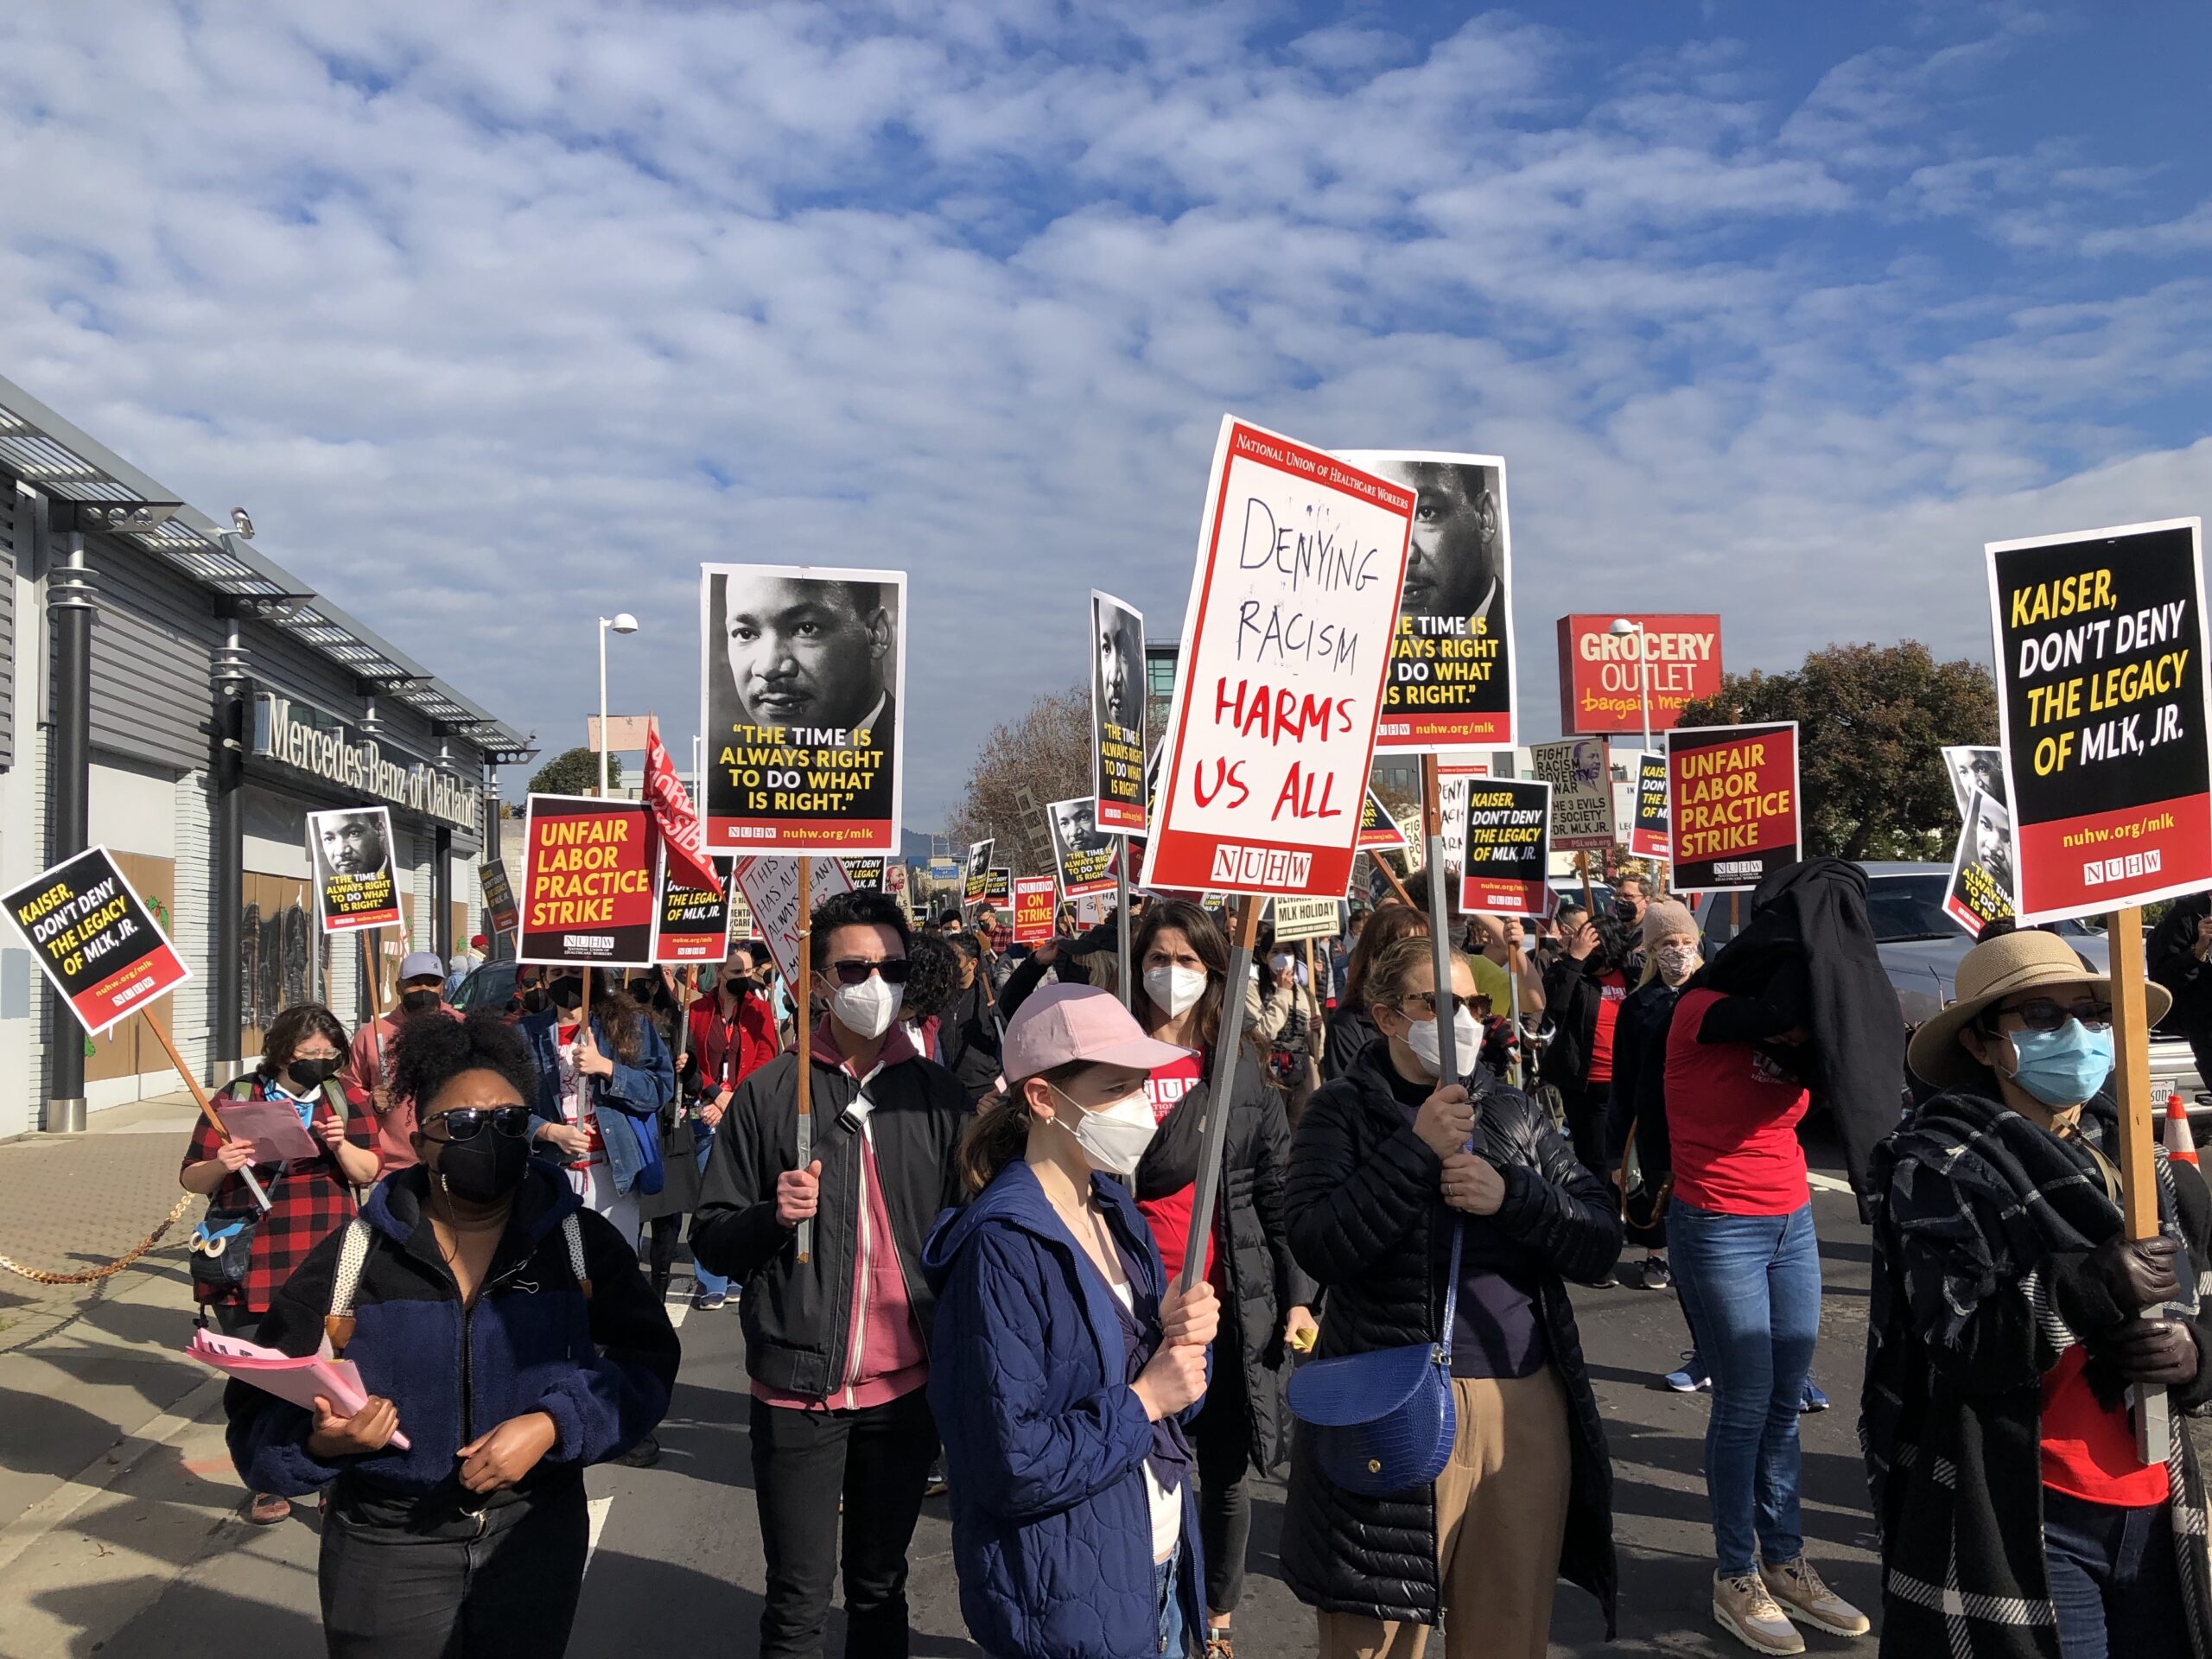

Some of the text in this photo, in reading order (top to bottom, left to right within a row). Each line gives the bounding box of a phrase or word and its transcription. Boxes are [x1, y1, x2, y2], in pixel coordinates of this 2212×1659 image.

[1236, 433, 1408, 510] NATIONAL UNION OF HEALTHCARE WORKERS
[1240, 497, 1379, 592] DENYING
[2012, 569, 2117, 628] KAISER,
[1418, 616, 1487, 635] TIME IS
[1236, 600, 1358, 676] RACISM
[1580, 632, 1714, 661] GROCERY
[2019, 600, 2185, 678] DON’T DENY
[1441, 639, 1498, 658] RIGHT
[1398, 662, 1492, 681] DO WHAT
[1601, 663, 1697, 691] OUTLET
[1407, 684, 1476, 704] RIGHT.”
[2028, 649, 2189, 728] THE LEGACY
[1215, 677, 1357, 747] HARMS
[1581, 688, 1653, 719] bargain
[733, 724, 872, 747] “THE TIME IS
[1122, 728, 1135, 745] TIME
[1135, 732, 1141, 747] IS
[1378, 722, 1494, 735] UHW nuhw.org/mlk
[2035, 703, 2183, 776] OF MLK, JR.
[267, 692, 475, 830] Mercedes-Benz of Oakland
[719, 747, 884, 768] ALWAYS RIGHT
[1102, 741, 1143, 765] ALWAYS RIGHT
[1536, 747, 1571, 760] FIGHT
[1681, 743, 1765, 780] UNFAIR
[1105, 760, 1141, 781] TO DO WHAT
[1537, 759, 1580, 772] RACISM
[728, 769, 874, 790] TO DO WHAT
[1539, 769, 1589, 783] POVERTY
[1111, 779, 1118, 794] IS
[1193, 756, 1249, 809] US
[1271, 760, 1342, 822] ALL
[1553, 782, 1579, 795] WAR
[1681, 771, 1758, 805] LABOR
[748, 791, 854, 811] IS RIGHT.”
[1471, 792, 1515, 809] KAISER,
[1568, 798, 1605, 810] 3 EVILS
[1643, 792, 1662, 804] THE
[1472, 810, 1542, 825] DON’T DENY
[1642, 807, 1657, 817] OF
[1681, 790, 1789, 831] PRACTICE
[540, 819, 628, 847] UNFAIR
[728, 827, 874, 841] NUHW nuhw.org/mlk
[1474, 828, 1541, 843] THE LEGACY
[1570, 823, 1592, 834] MLK
[1594, 822, 1610, 833] JR.
[2063, 813, 2175, 848] nuhw.org/mlk
[1681, 822, 1758, 857] STRIKE
[537, 846, 618, 873] LABOR
[1065, 857, 1094, 868] ALWAYS
[1086, 848, 1104, 857] TIME
[1473, 846, 1536, 862] OF MLK, JR.
[353, 872, 376, 882] TIME
[377, 871, 385, 880] IS
[746, 856, 778, 891] THIS
[854, 869, 880, 878] LEGACY
[1068, 867, 1079, 875] TO
[1213, 849, 1311, 884] NUHW
[1714, 861, 1762, 874] NUHW
[1971, 861, 1995, 887] “THE
[2085, 850, 2160, 884] NUHW
[327, 880, 391, 894] ALWAYS RIGHT
[535, 869, 649, 899] PRACTICE
[1018, 881, 1053, 893] NUHW
[1481, 883, 1529, 892] nuhw.org/mlk
[1962, 868, 2001, 906] ALWAYS
[18, 883, 74, 925] KAISER,
[331, 889, 389, 904] TO DO WHAT
[668, 893, 688, 906] THE
[756, 886, 781, 919] HAS
[1027, 894, 1044, 906] ON
[1488, 895, 1522, 906] NUHW
[1965, 880, 1995, 912] TO DO
[1970, 898, 1980, 911] IS
[33, 877, 115, 943] DON’T DENY
[340, 903, 350, 912] IS
[531, 898, 614, 926] STRIKE
[667, 908, 683, 921] OF
[683, 906, 706, 920] MLK,
[707, 905, 721, 918] JR.
[1017, 907, 1052, 923] STRIKE
[1279, 902, 1334, 921] MLK HOLIDAY
[48, 895, 128, 959] THE LEGACY
[63, 918, 138, 976] OF MLK, JR.
[564, 935, 614, 948] NUHW
[95, 959, 154, 997] nuhw.org/mlk
[111, 976, 156, 1007] NUHW
